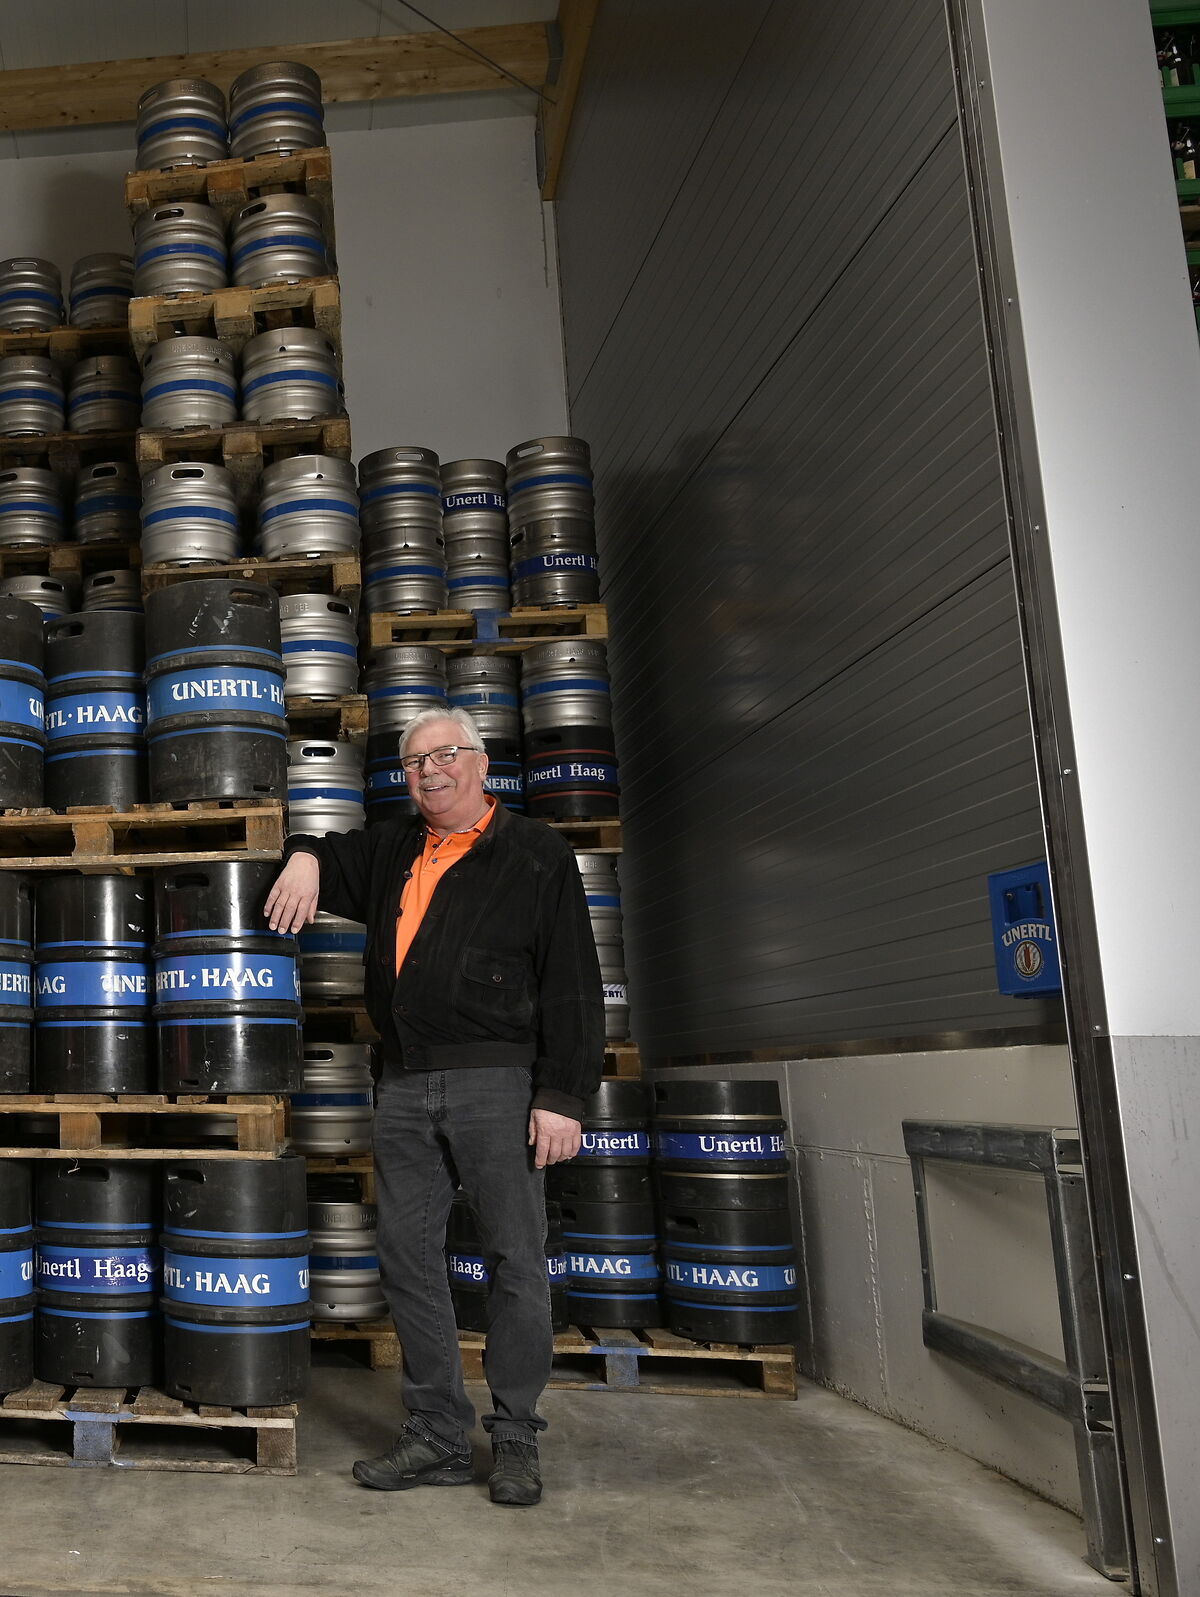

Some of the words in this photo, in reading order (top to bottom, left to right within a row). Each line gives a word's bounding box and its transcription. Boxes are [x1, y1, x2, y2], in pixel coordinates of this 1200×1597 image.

[446, 493, 487, 508] Unertl
[542, 554, 586, 567] Unertl
[528, 765, 562, 783] Unertl
[569, 763, 606, 781] Haag
[1001, 923, 1053, 947] UNERTL
[581, 1133, 640, 1149] Unertl
[699, 1135, 764, 1154] Unertl
[93, 1259, 150, 1283] Haag
[450, 1255, 484, 1280] Haag
[571, 1256, 632, 1275] HAAG
